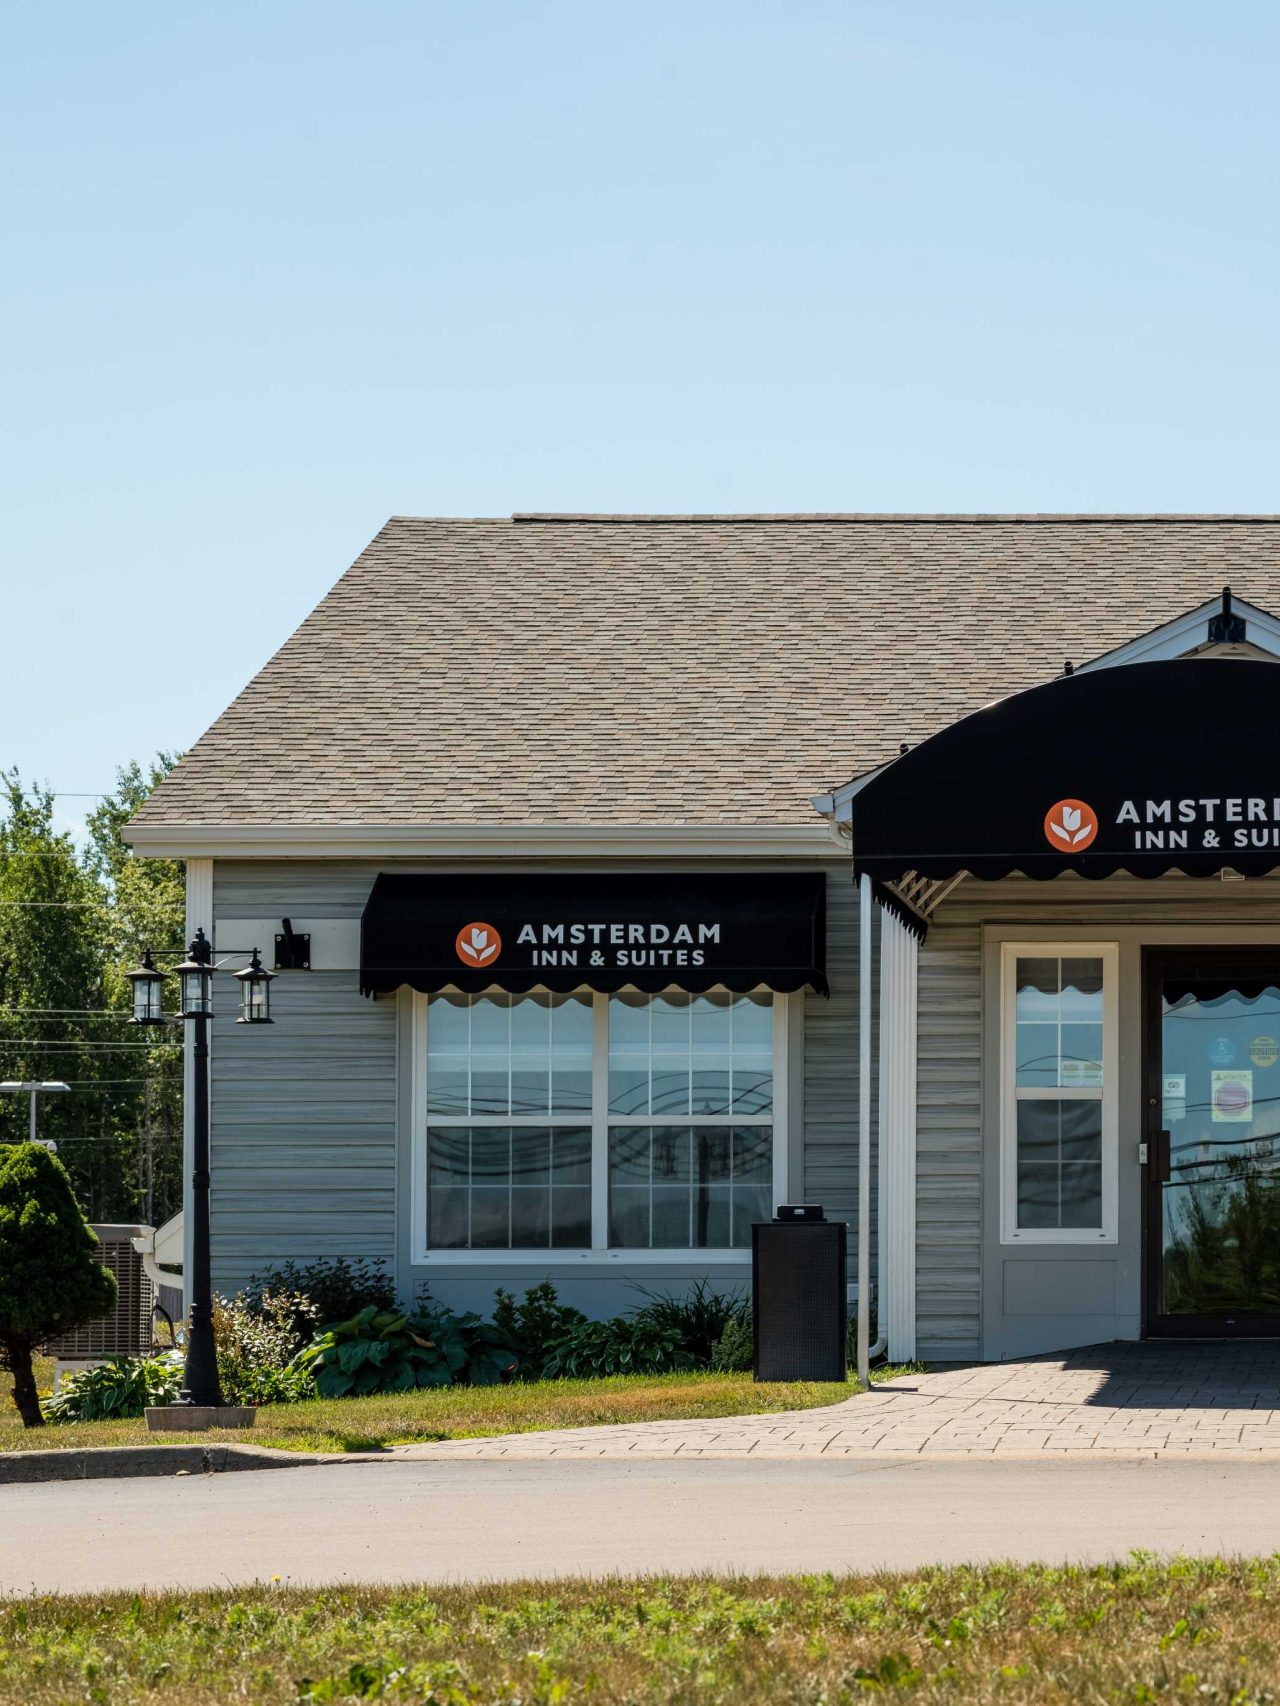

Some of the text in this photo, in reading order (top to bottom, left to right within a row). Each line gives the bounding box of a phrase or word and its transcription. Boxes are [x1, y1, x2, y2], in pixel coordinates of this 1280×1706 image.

[1134, 829, 1188, 849] INN
[1202, 829, 1221, 848] &
[516, 923, 720, 945] AMSTERDAM
[532, 949, 705, 966] INN & SUITES
